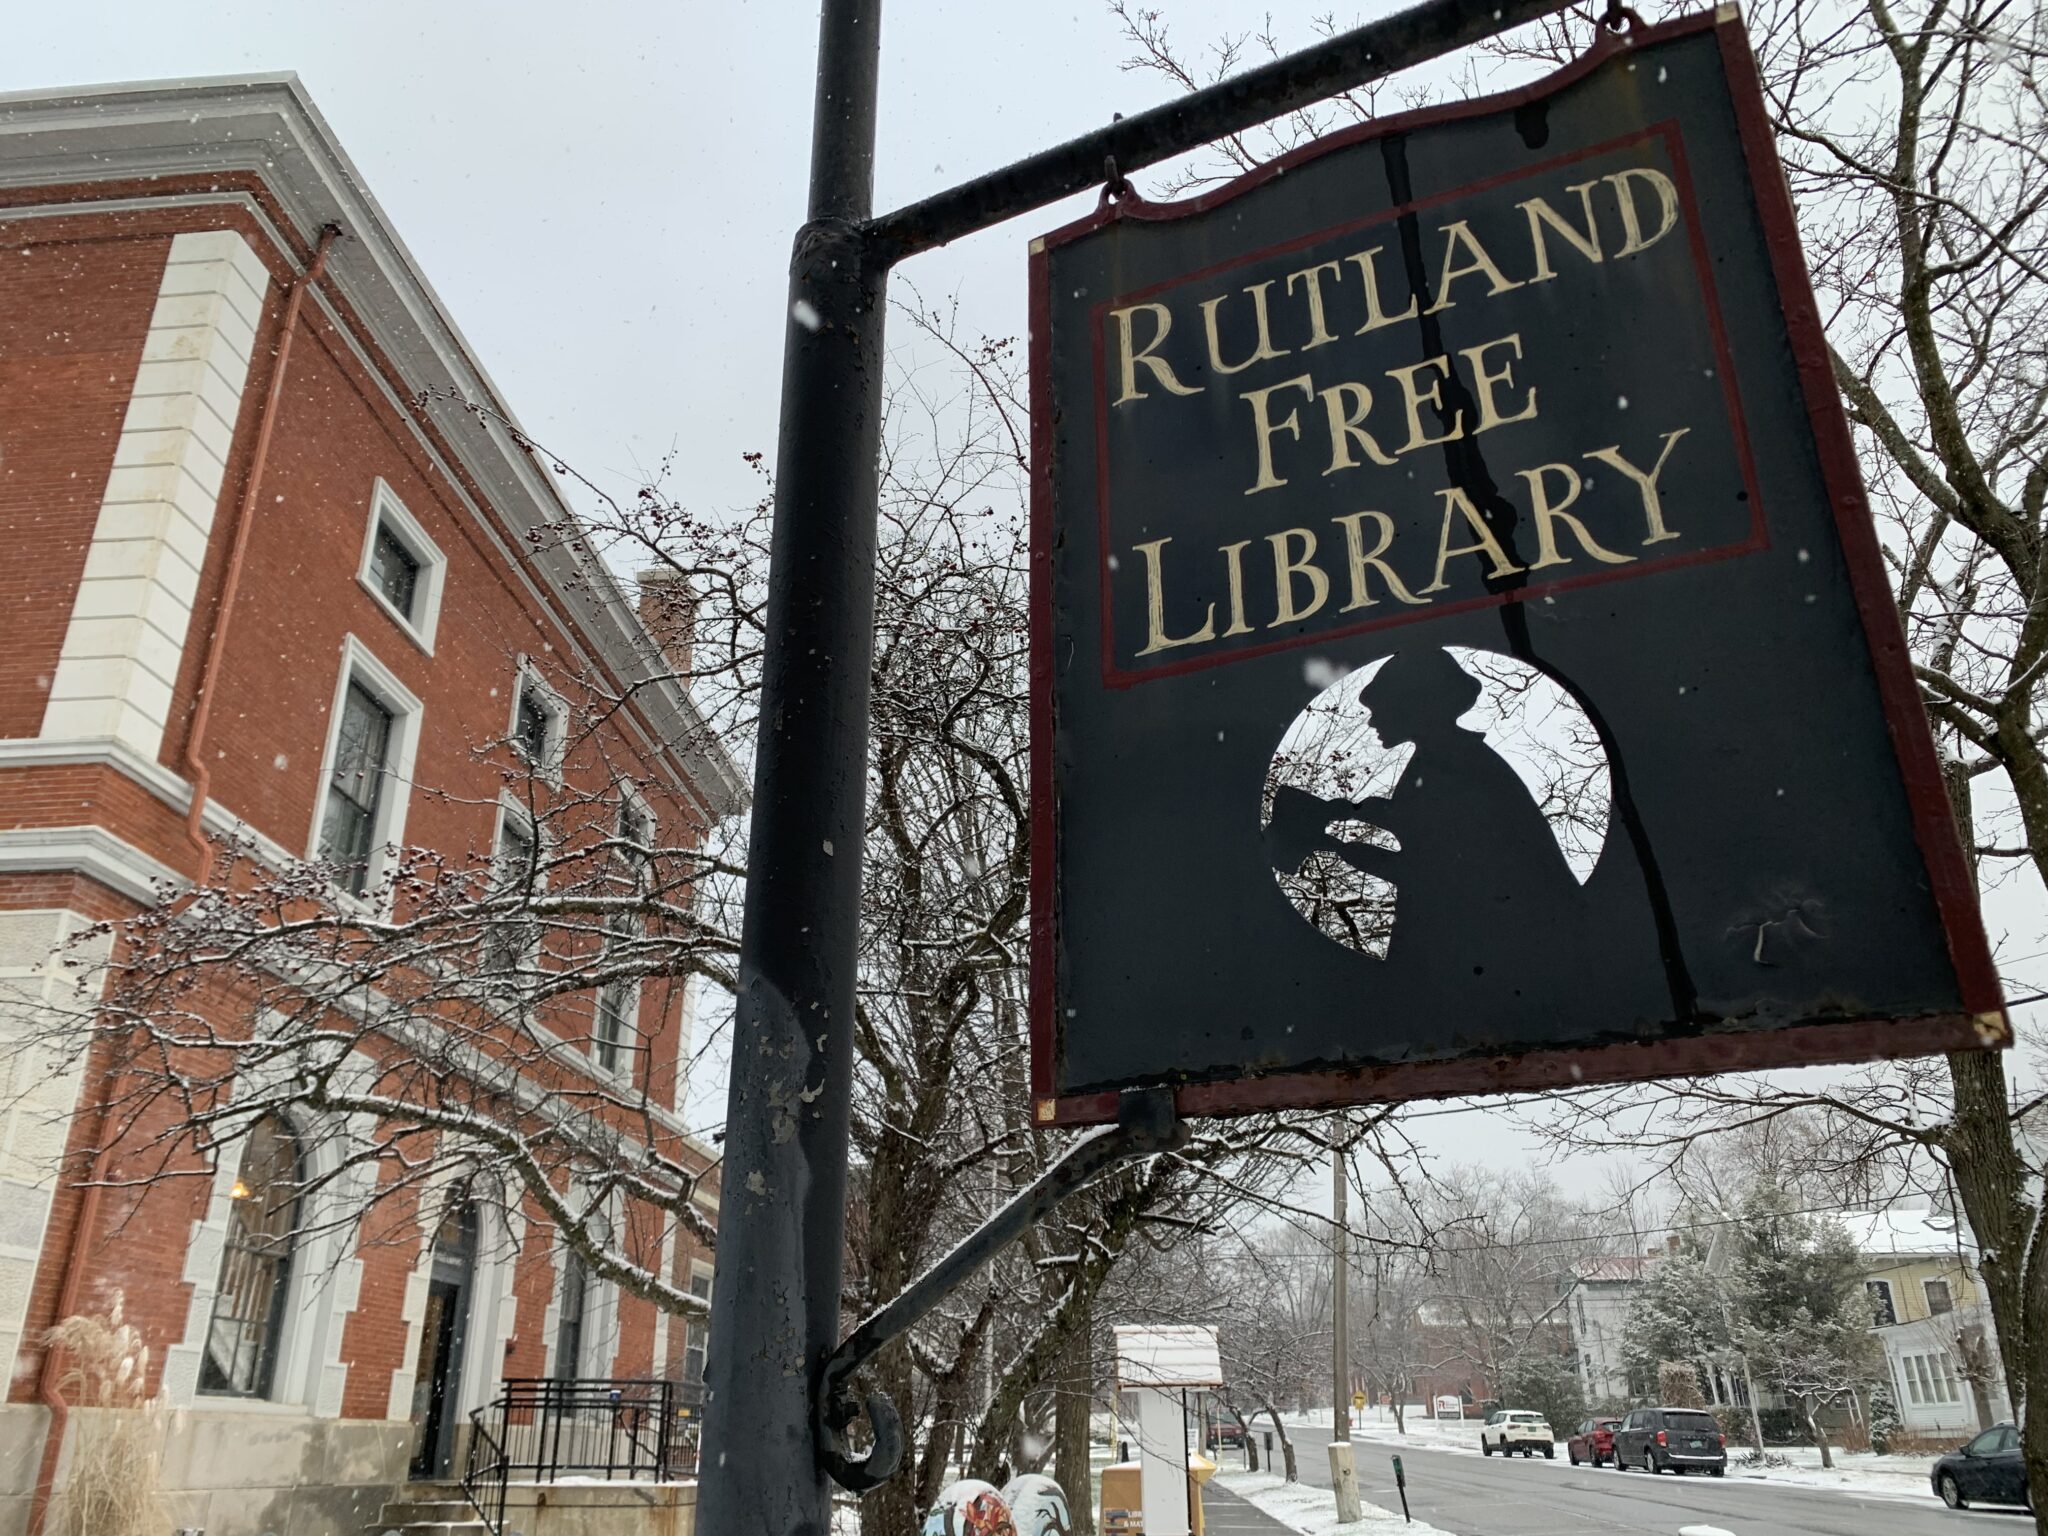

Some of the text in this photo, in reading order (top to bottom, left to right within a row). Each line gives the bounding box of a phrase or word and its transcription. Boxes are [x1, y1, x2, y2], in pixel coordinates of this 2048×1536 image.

[1109, 168, 1680, 406] RUTLAND
[1239, 333, 1537, 496] FREE
[1132, 427, 1691, 657] LIBRARY
